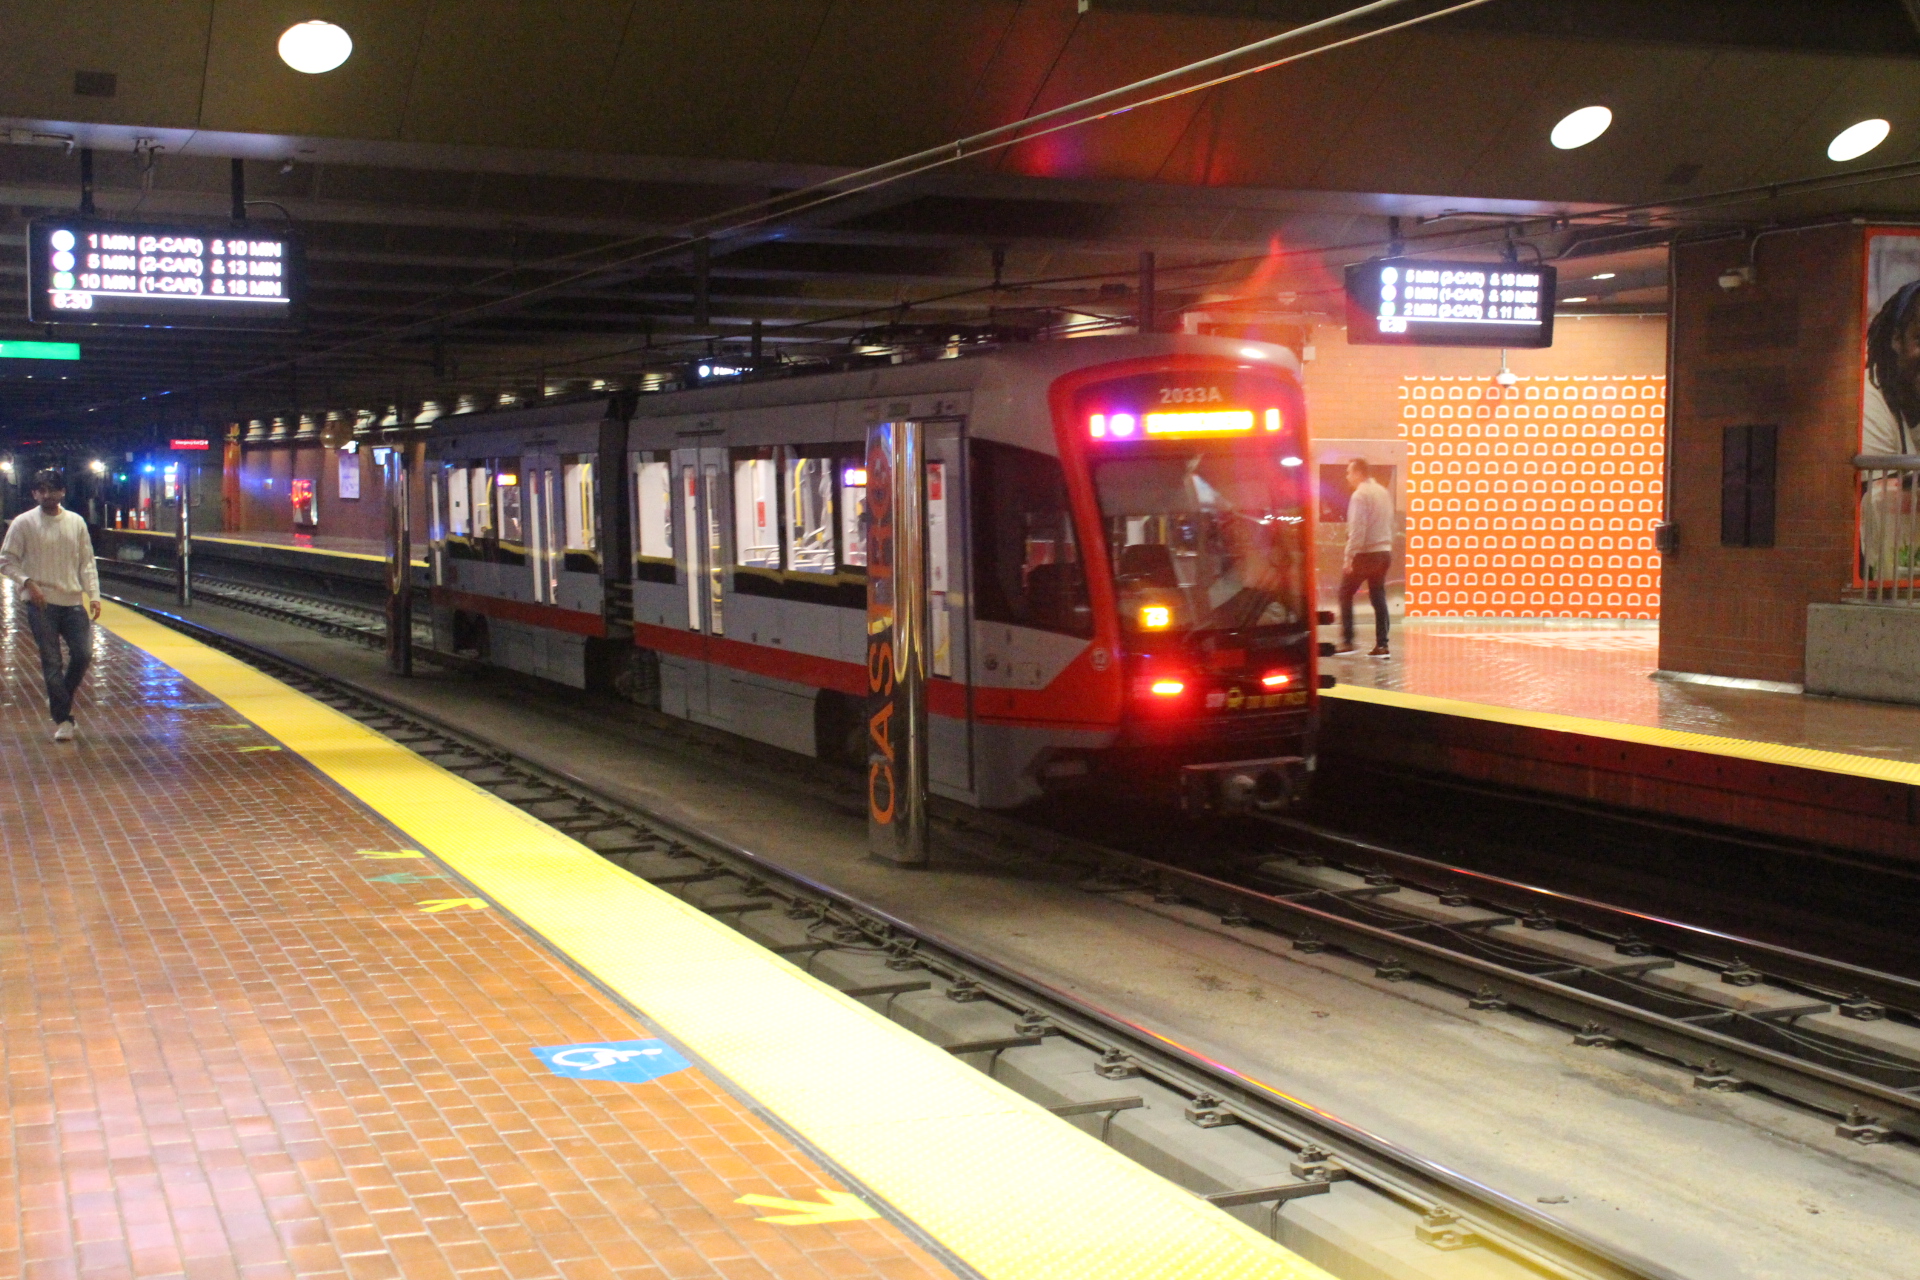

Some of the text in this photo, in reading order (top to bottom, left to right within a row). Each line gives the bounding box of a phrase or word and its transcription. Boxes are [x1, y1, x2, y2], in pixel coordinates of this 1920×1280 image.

[88, 234, 98, 249] 1
[101, 235, 135, 251] MIN
[139, 236, 203, 257] (2-CAR)
[211, 239, 225, 255] &
[249, 242, 282, 257] MIN
[101, 255, 135, 271] MIN
[139, 256, 203, 276] (2-CAR)
[211, 259, 225, 274] &
[249, 261, 282, 277] MIN
[79, 273, 101, 289] 10
[101, 274, 135, 290] MIN
[211, 279, 225, 294] &
[249, 281, 282, 296] MIN
[1159, 386, 1223, 404] 2033A
